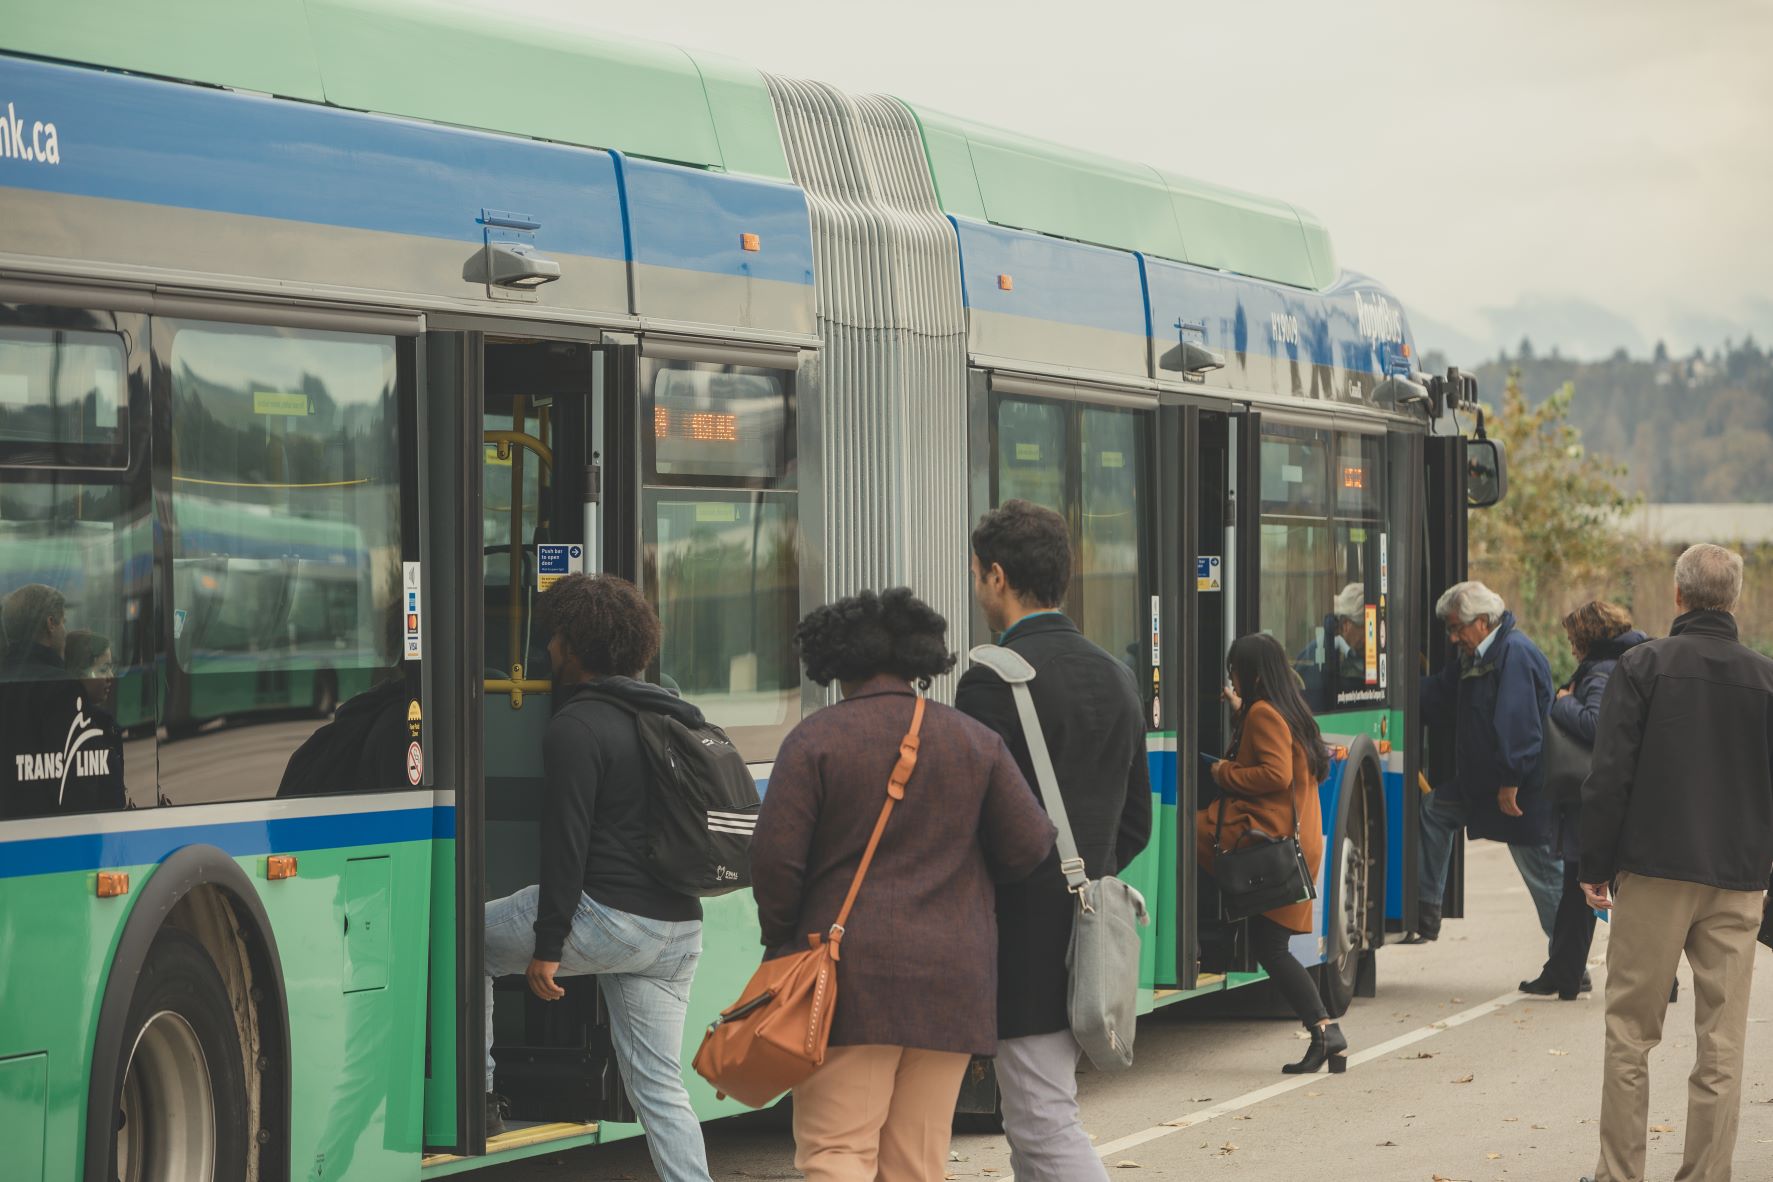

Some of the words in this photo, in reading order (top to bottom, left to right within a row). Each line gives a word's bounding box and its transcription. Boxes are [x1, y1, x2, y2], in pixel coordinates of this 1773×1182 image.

[1354, 290, 1402, 350] RapidBus
[16, 751, 64, 781] TRANS
[76, 749, 110, 777] LINK
[725, 870, 739, 878] FINAL
